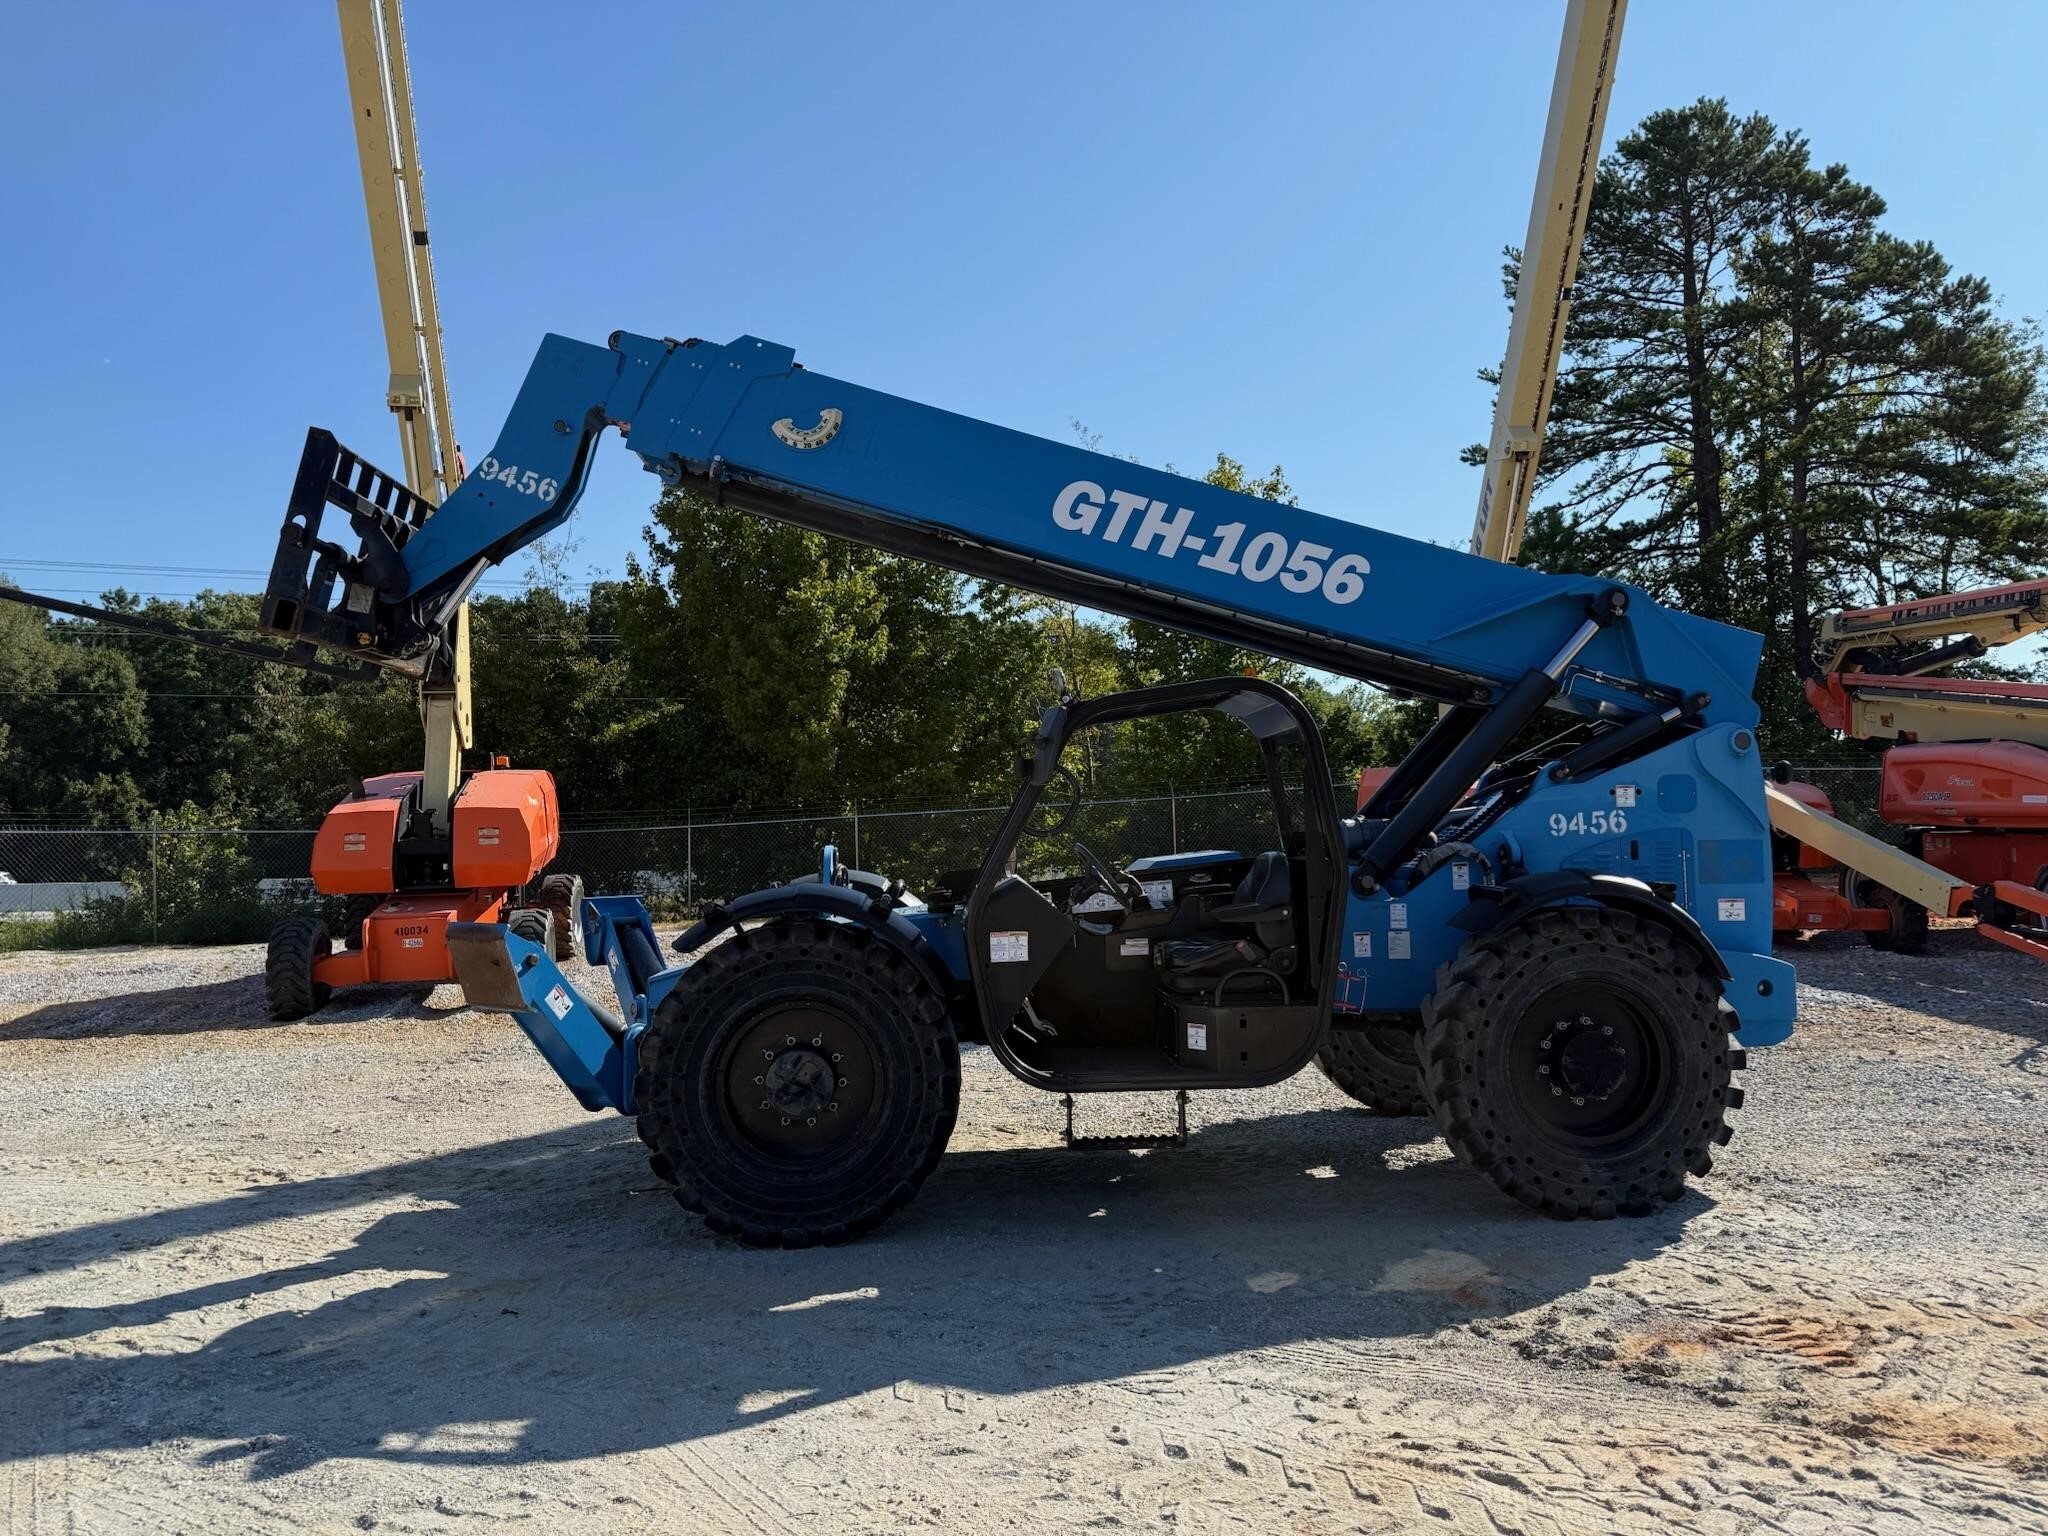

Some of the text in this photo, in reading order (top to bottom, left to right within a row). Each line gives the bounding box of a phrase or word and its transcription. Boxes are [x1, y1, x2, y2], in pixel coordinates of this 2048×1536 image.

[480, 456, 558, 502] 9456
[1052, 480, 1371, 605] GTH-1056
[1549, 809, 1628, 837] 9456
[393, 925, 429, 936] 410034
